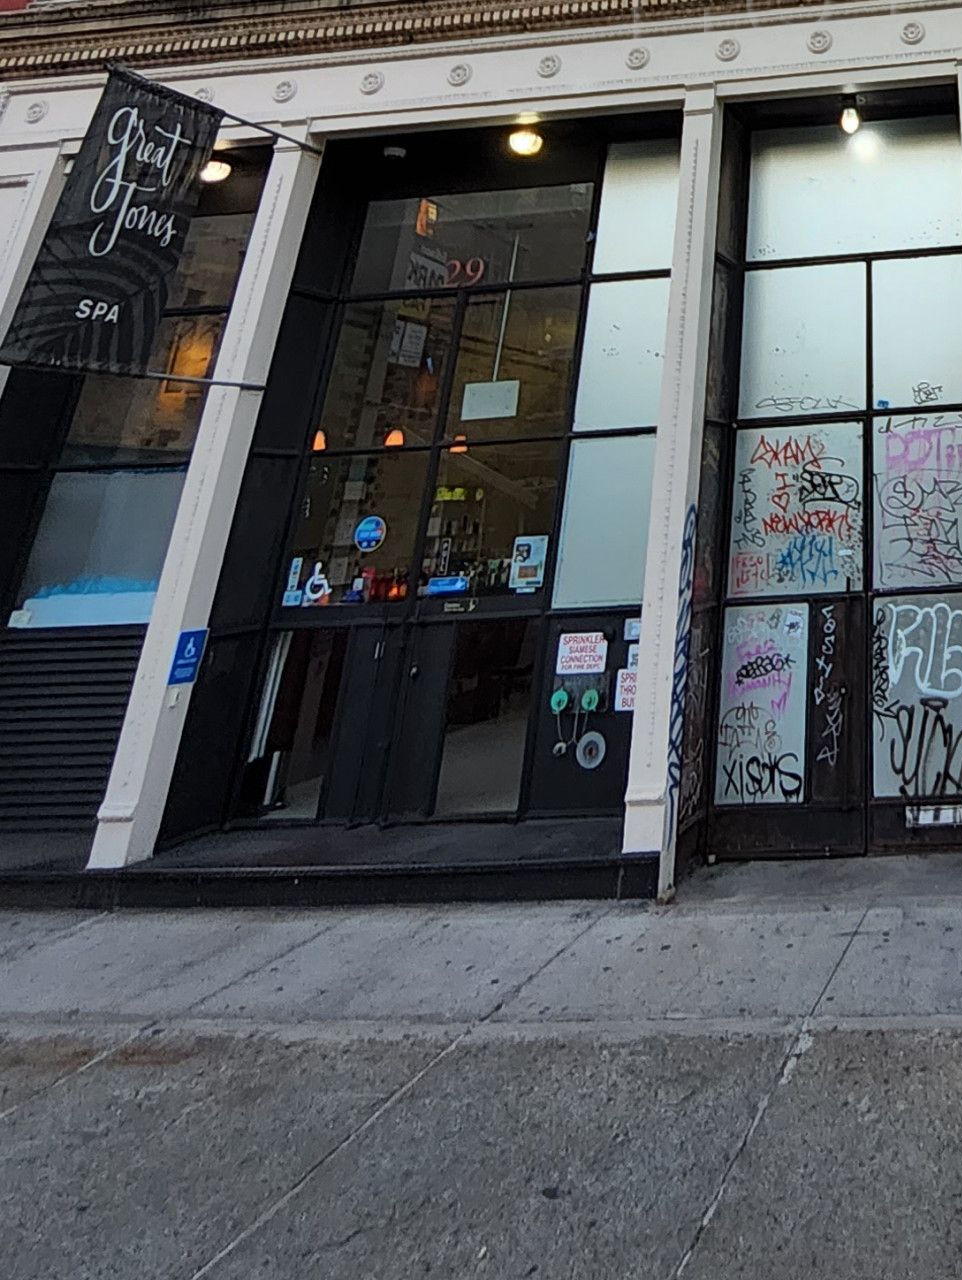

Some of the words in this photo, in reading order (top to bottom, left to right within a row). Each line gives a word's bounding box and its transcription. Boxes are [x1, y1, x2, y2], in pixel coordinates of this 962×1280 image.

[88, 181, 178, 257] Jones
[444, 256, 486, 289] 29
[74, 298, 120, 324] SPA
[562, 634, 606, 646] SPRINKLER
[560, 654, 604, 665] CONNECTION
